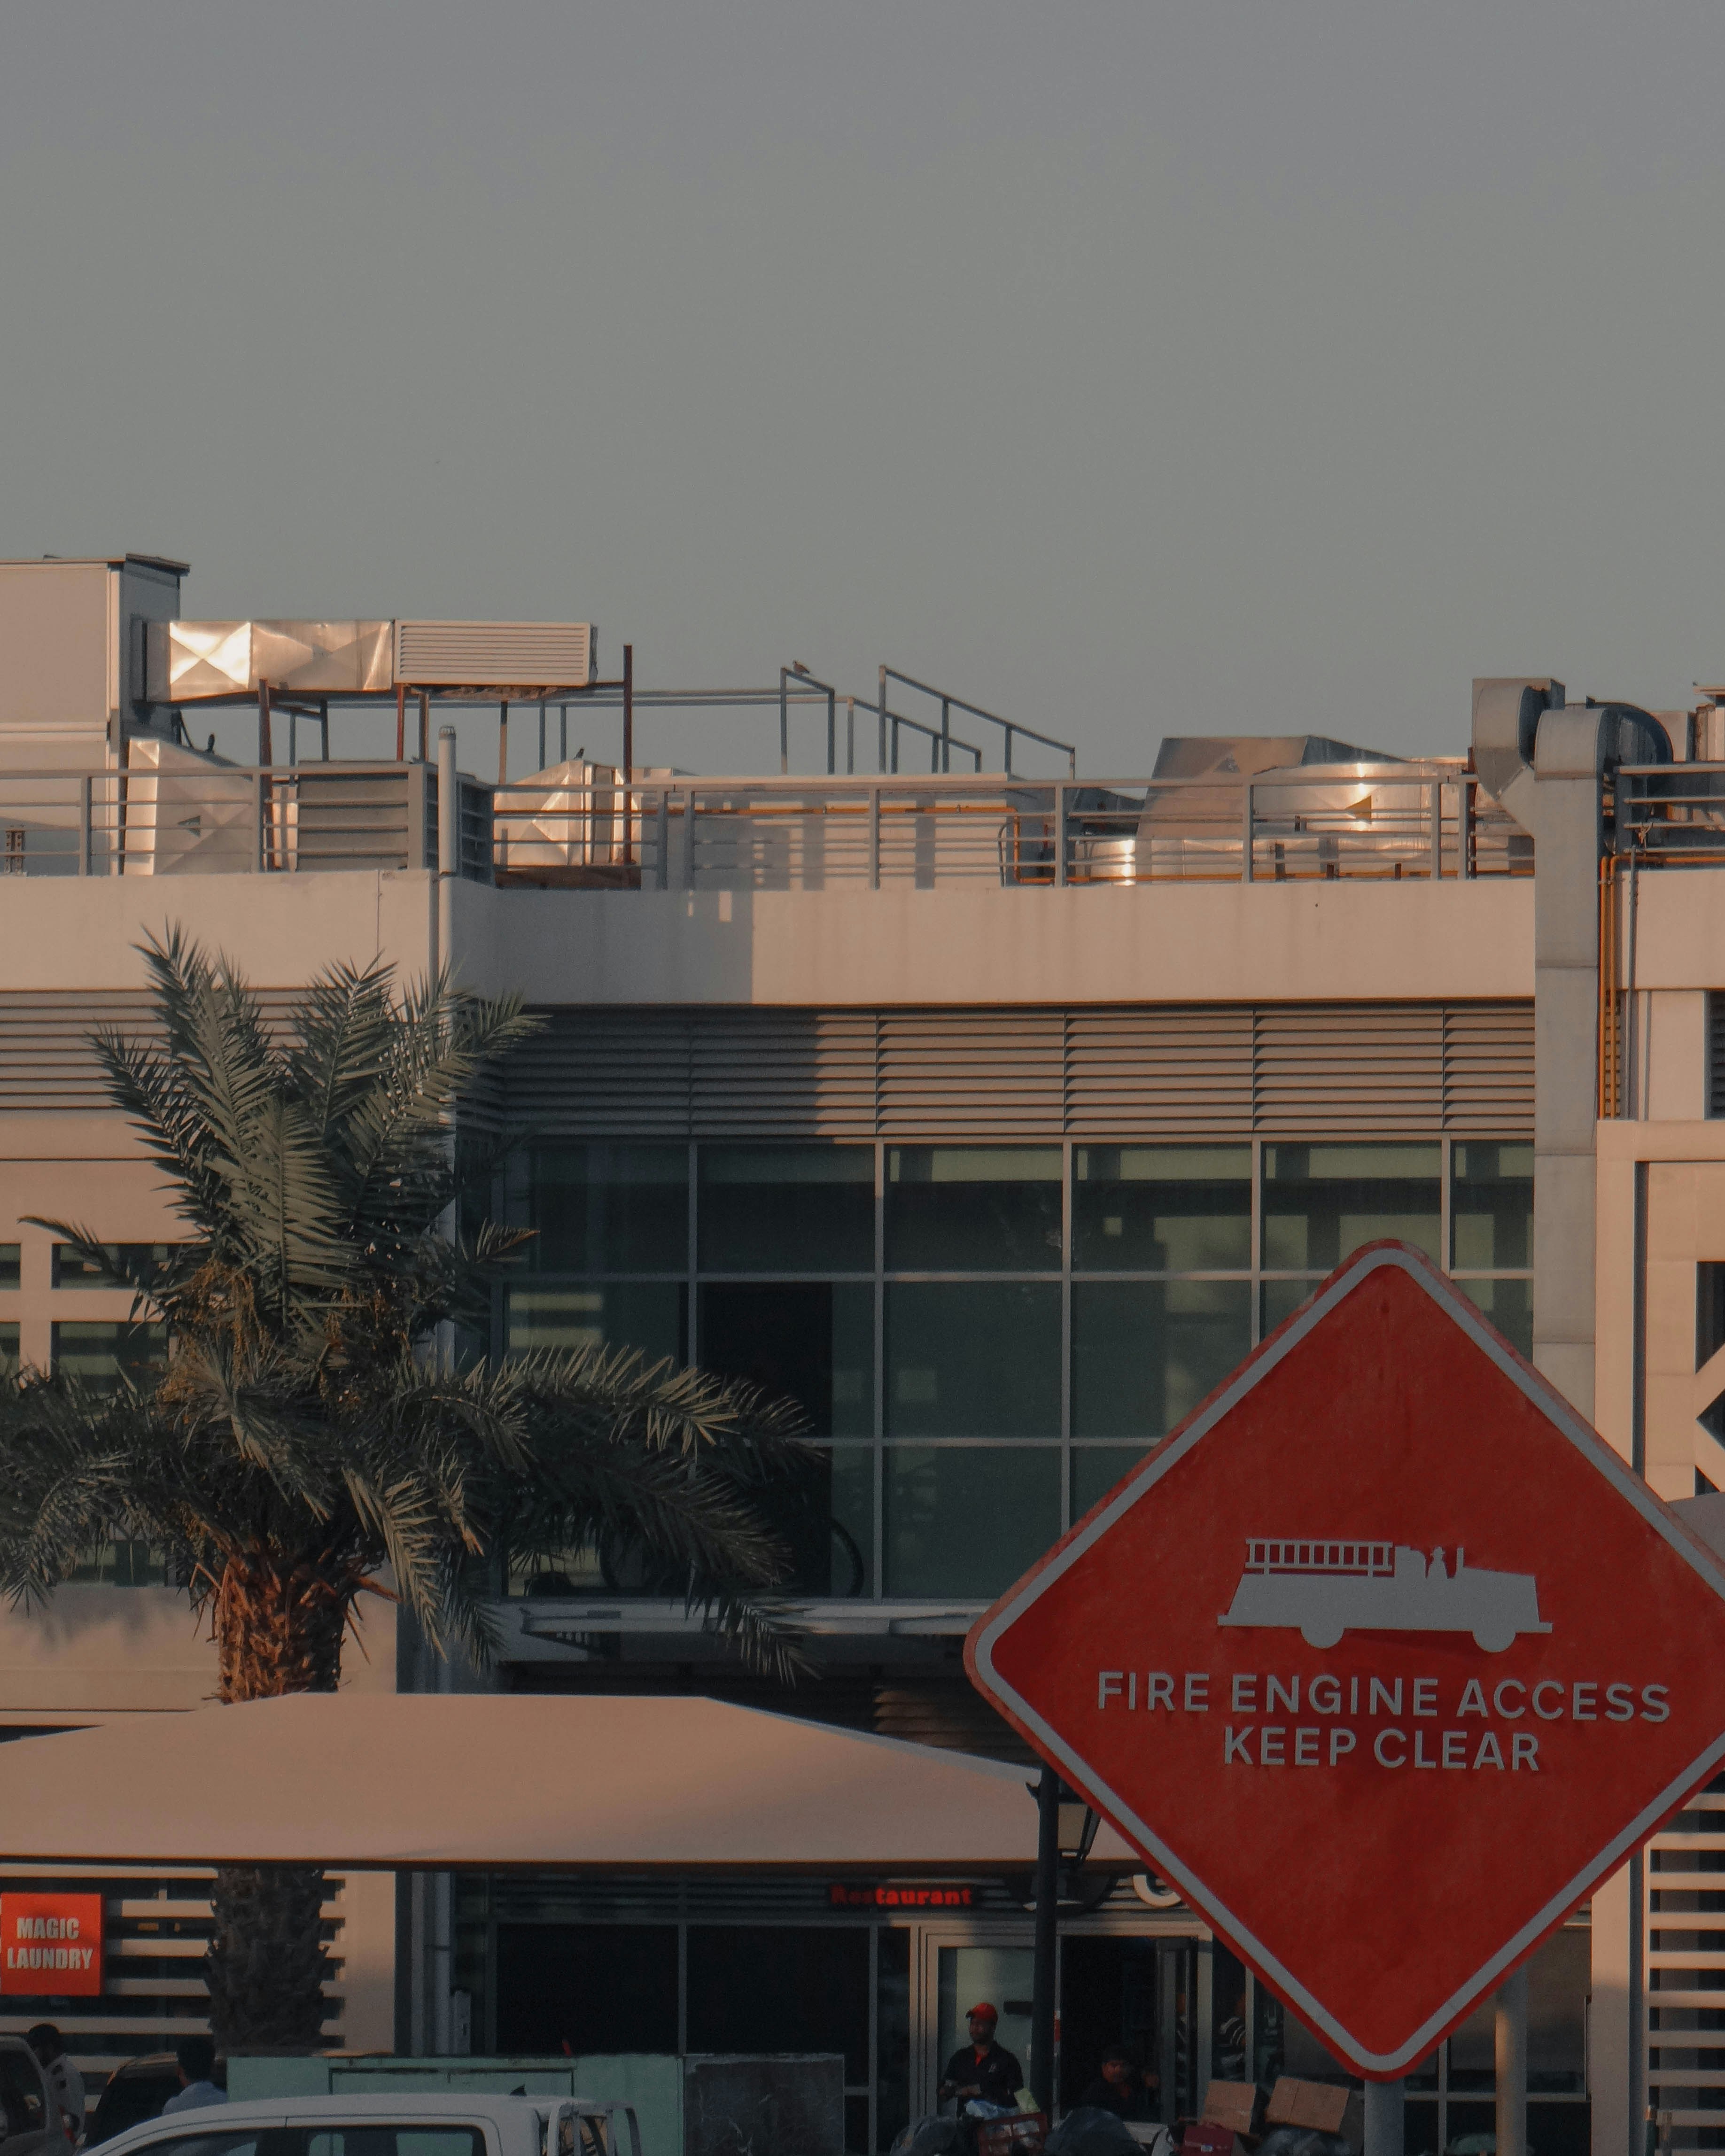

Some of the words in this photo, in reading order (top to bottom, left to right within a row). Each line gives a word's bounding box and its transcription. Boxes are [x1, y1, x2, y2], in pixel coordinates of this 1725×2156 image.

[1098, 1671, 1210, 1712] FIRE
[1232, 1674, 1438, 1716] ENGINE
[1456, 1678, 1670, 1722] ACCESS
[1224, 1726, 1357, 1766] KEEP
[1373, 1728, 1539, 1771] CLEAR
[16, 1917, 79, 1939] MAGIC
[7, 1947, 93, 1969] LAUNDRY
